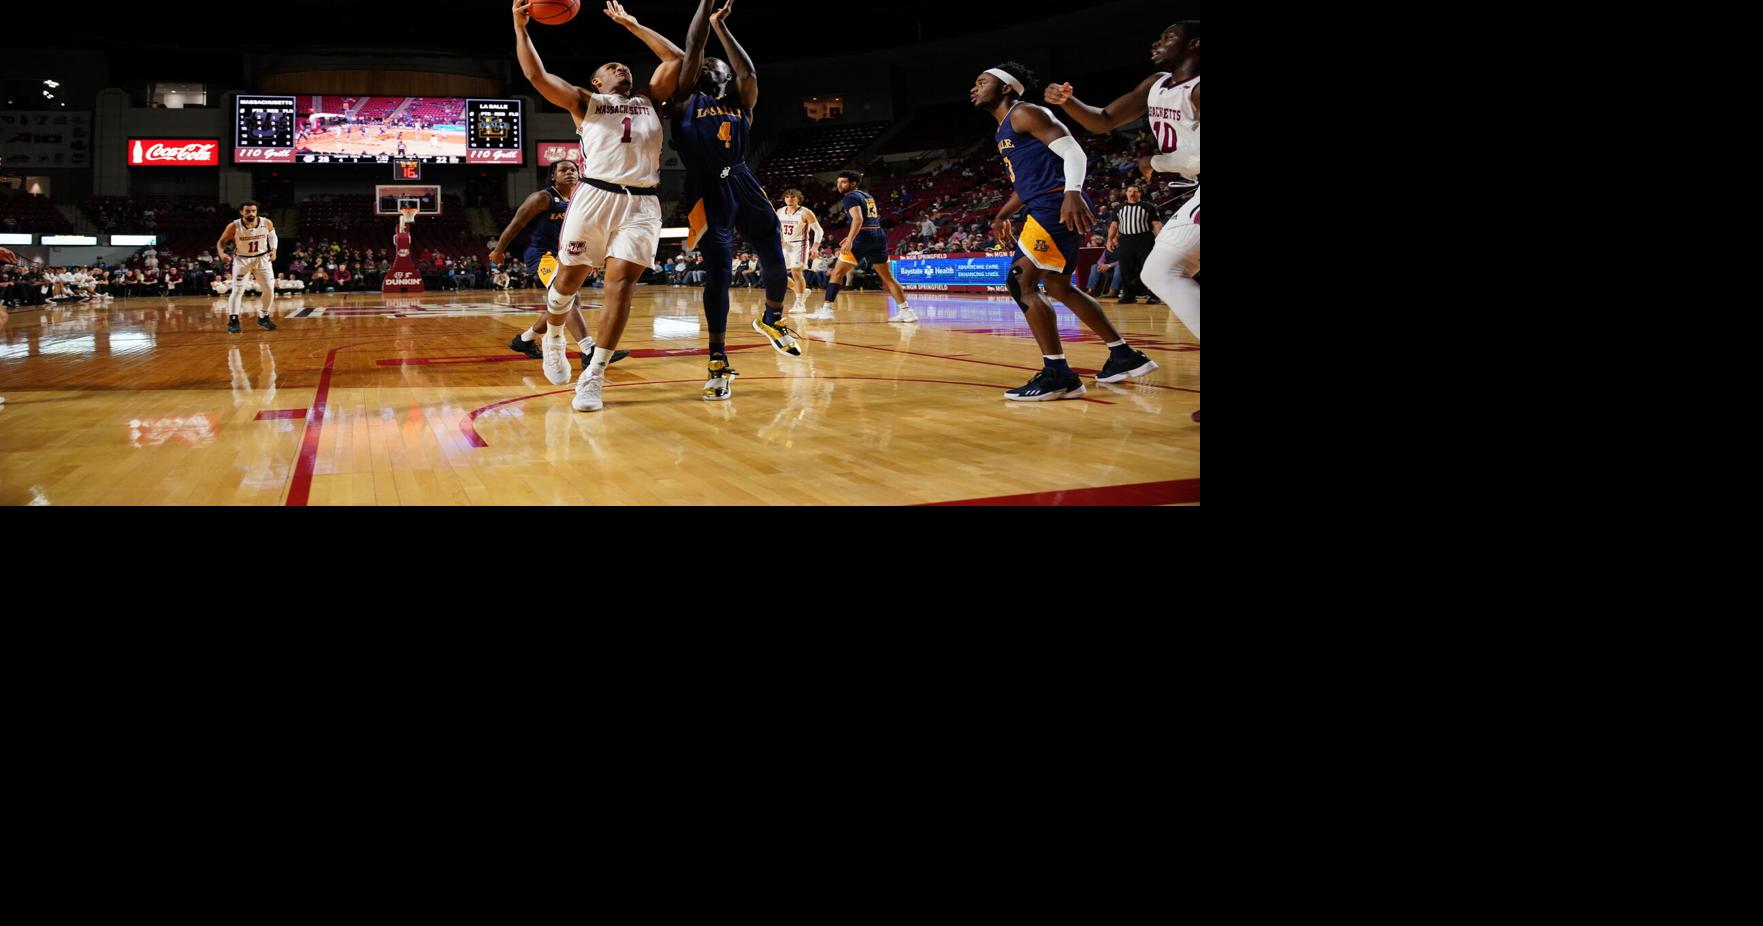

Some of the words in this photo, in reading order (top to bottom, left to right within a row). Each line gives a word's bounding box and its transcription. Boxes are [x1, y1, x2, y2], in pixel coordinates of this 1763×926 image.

[595, 104, 650, 115] MASSACHSETTS
[621, 117, 632, 143] 1
[717, 121, 732, 149] 4
[1153, 121, 1178, 153] 10
[145, 143, 216, 161] Coca-Cola
[240, 148, 262, 157] 110
[263, 148, 291, 159] Grill
[470, 150, 491, 158] 110
[493, 150, 518, 160] Grill
[403, 167, 417, 178] 16
[783, 224, 795, 235] 33
[248, 241, 259, 253] 11
[900, 267, 924, 277] Baystate
[934, 266, 955, 274] Health
[385, 278, 422, 286] DUNKIN'
